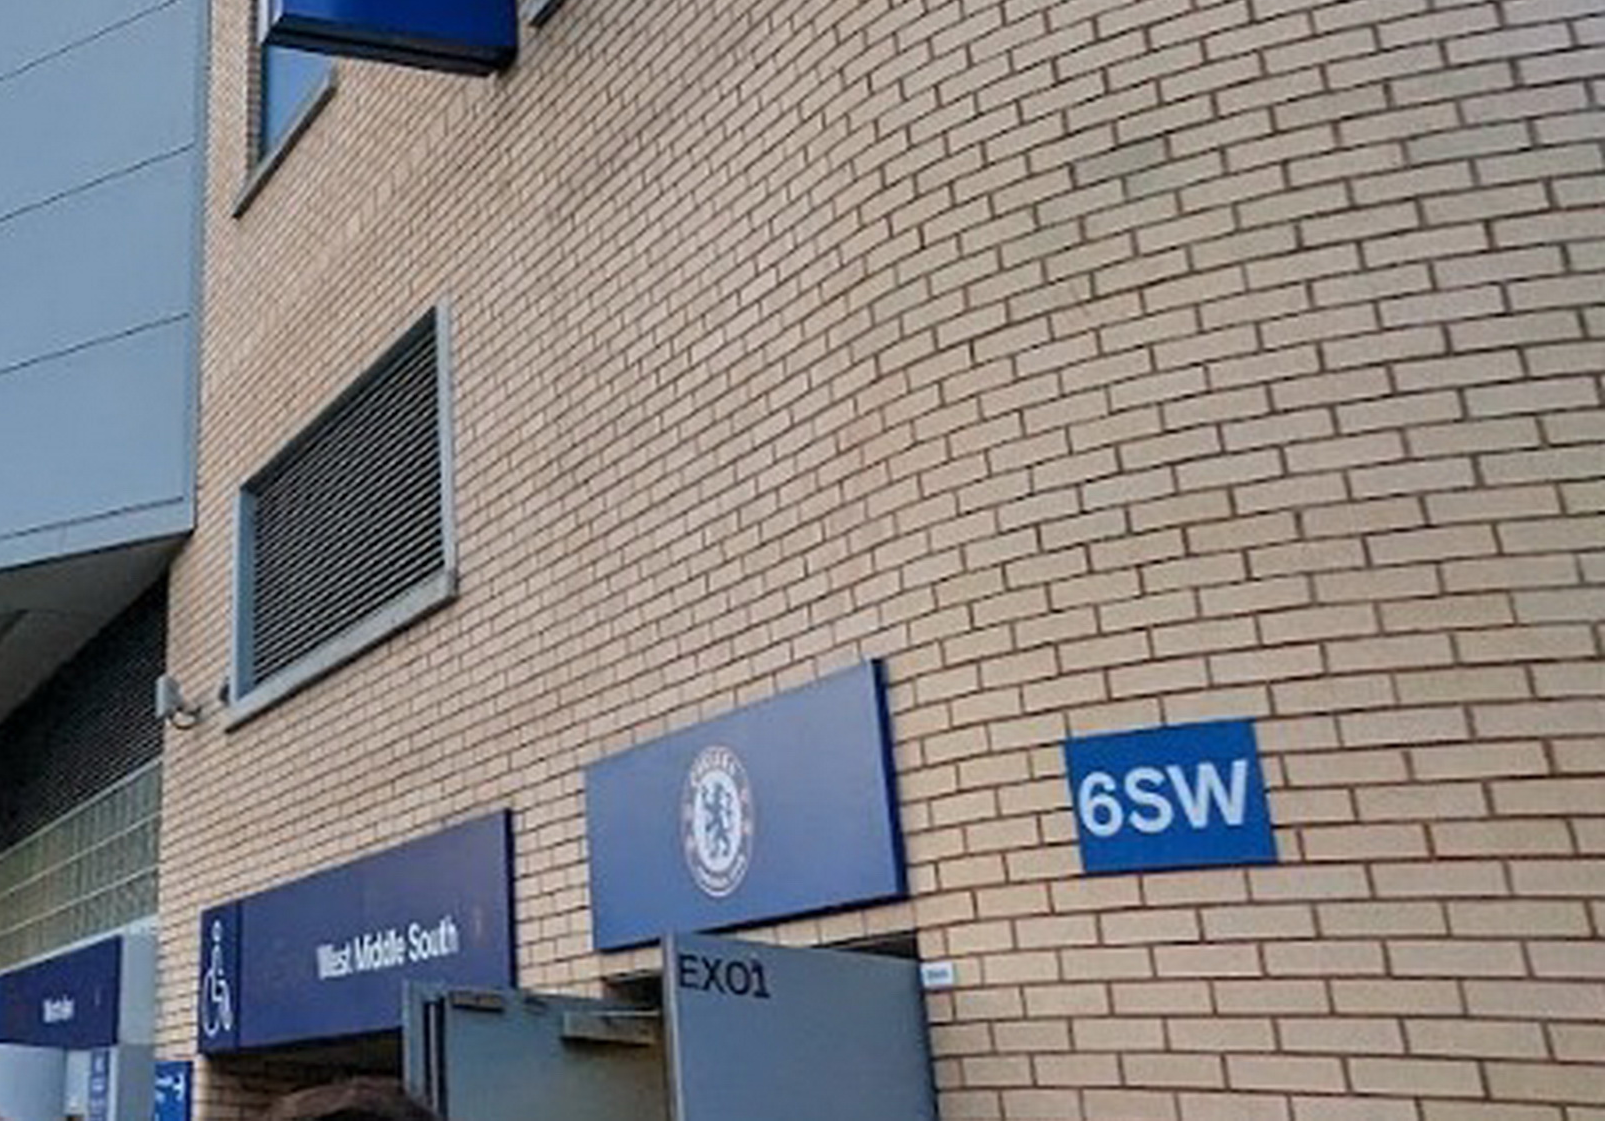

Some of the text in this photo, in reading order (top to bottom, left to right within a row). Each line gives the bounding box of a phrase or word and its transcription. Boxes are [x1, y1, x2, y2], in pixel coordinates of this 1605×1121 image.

[1078, 759, 1248, 838] 6SW
[317, 915, 458, 979] West Middle South
